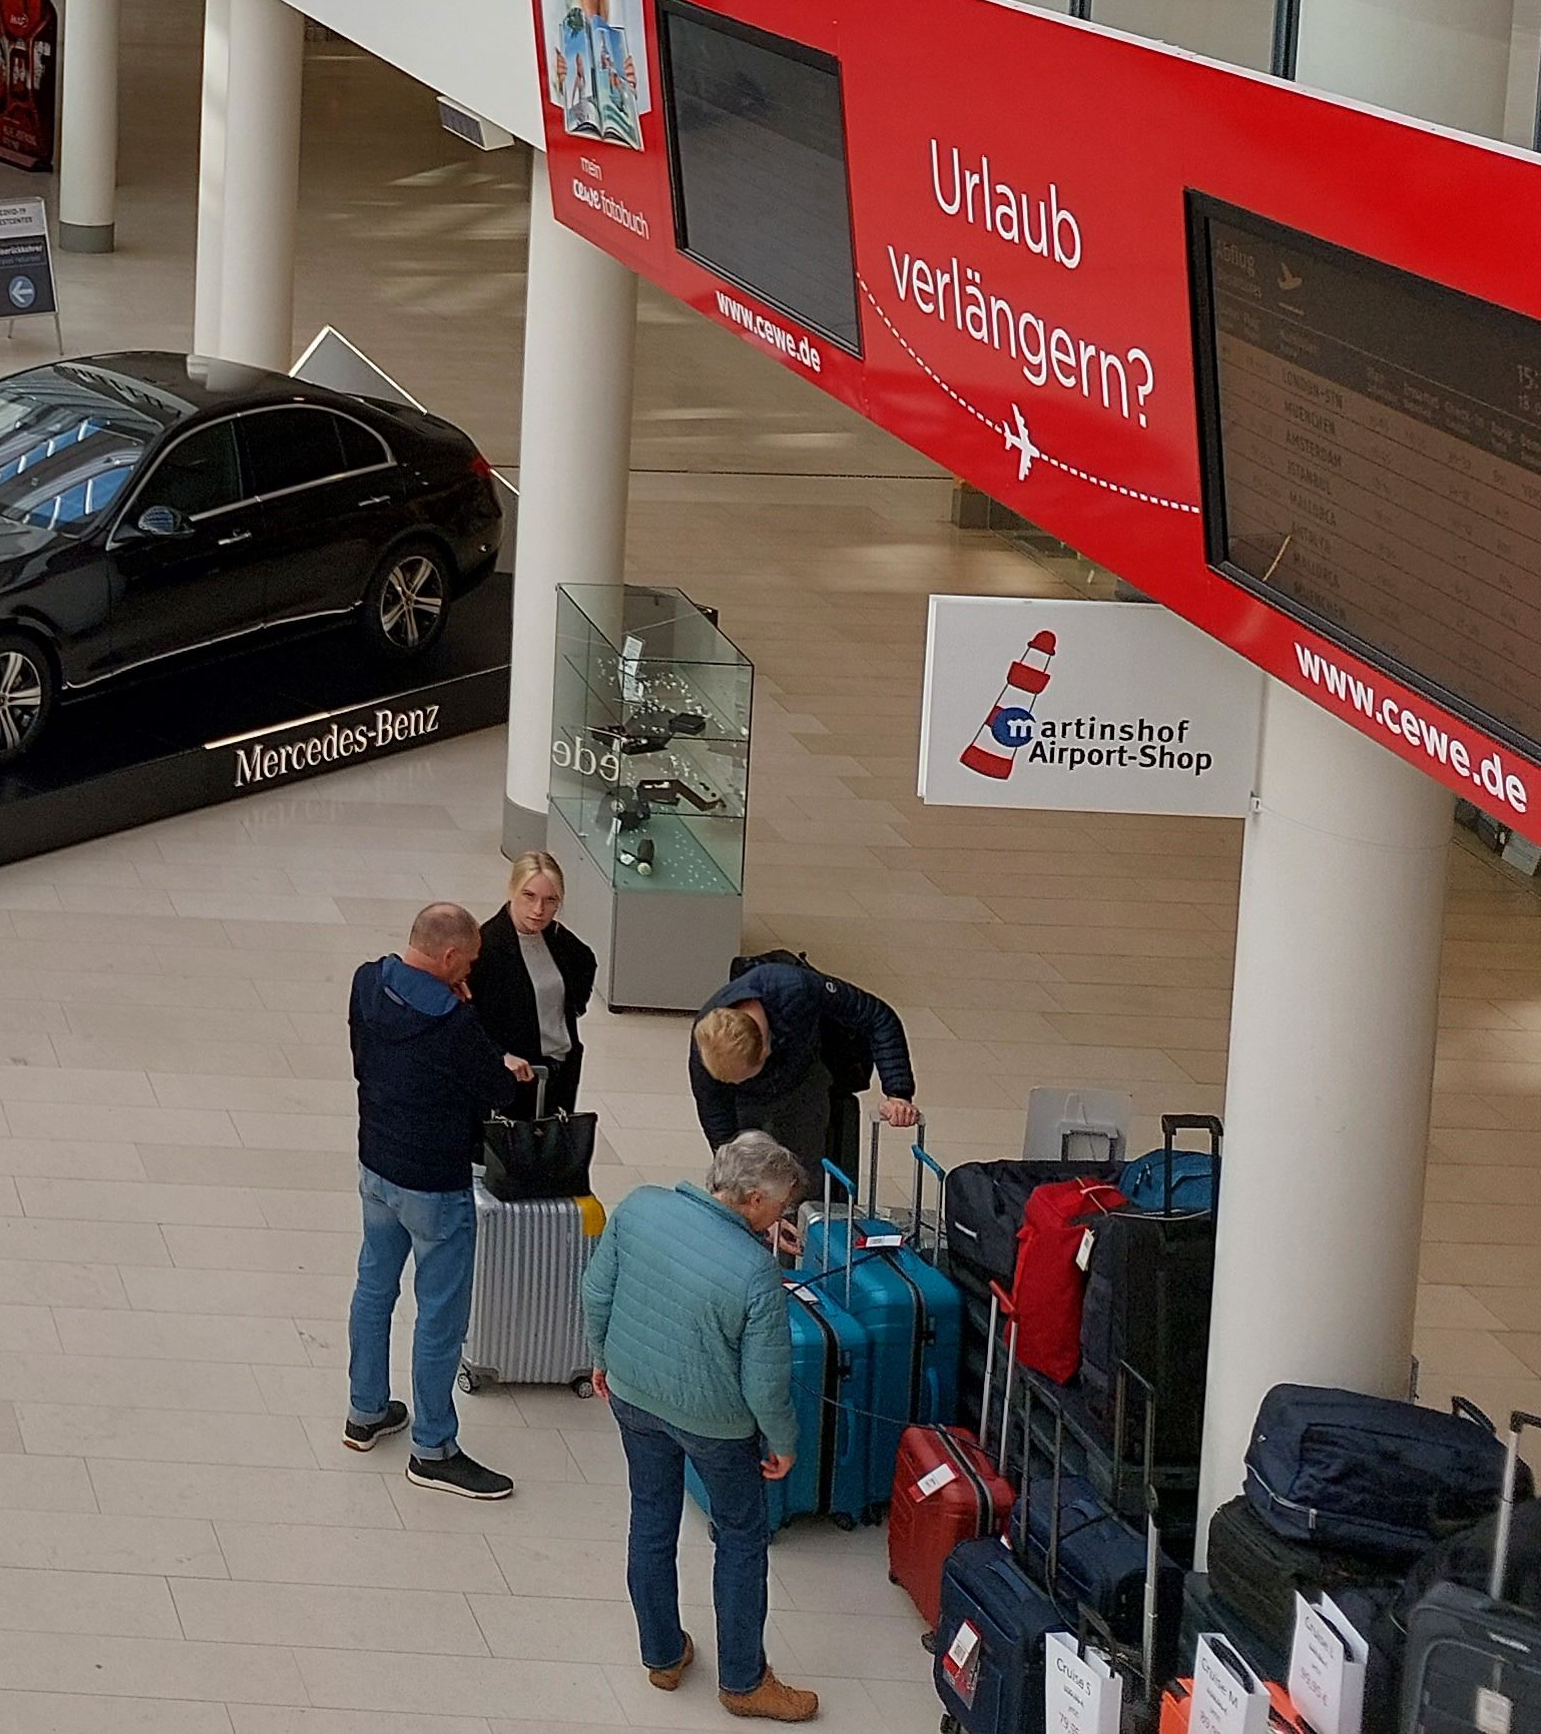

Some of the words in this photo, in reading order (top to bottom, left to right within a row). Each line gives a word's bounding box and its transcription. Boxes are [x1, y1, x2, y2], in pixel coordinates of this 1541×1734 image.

[580, 156, 602, 181] mein
[930, 138, 1082, 269] Urlaub
[572, 178, 601, 210] cewe
[600, 189, 650, 240] fotobuch
[715, 290, 822, 373] www.cewe.de
[887, 244, 1155, 429] verlängern?
[233, 704, 440, 788] Mercedes-Benz
[1028, 740, 1214, 776] Airport-Shop
[1294, 642, 1528, 814] www.cewe.de
[1056, 1657, 1084, 1690] Cruise
[1085, 1681, 1091, 1696] S
[1201, 1657, 1227, 1696] Cruise
[1228, 1690, 1238, 1709] M
